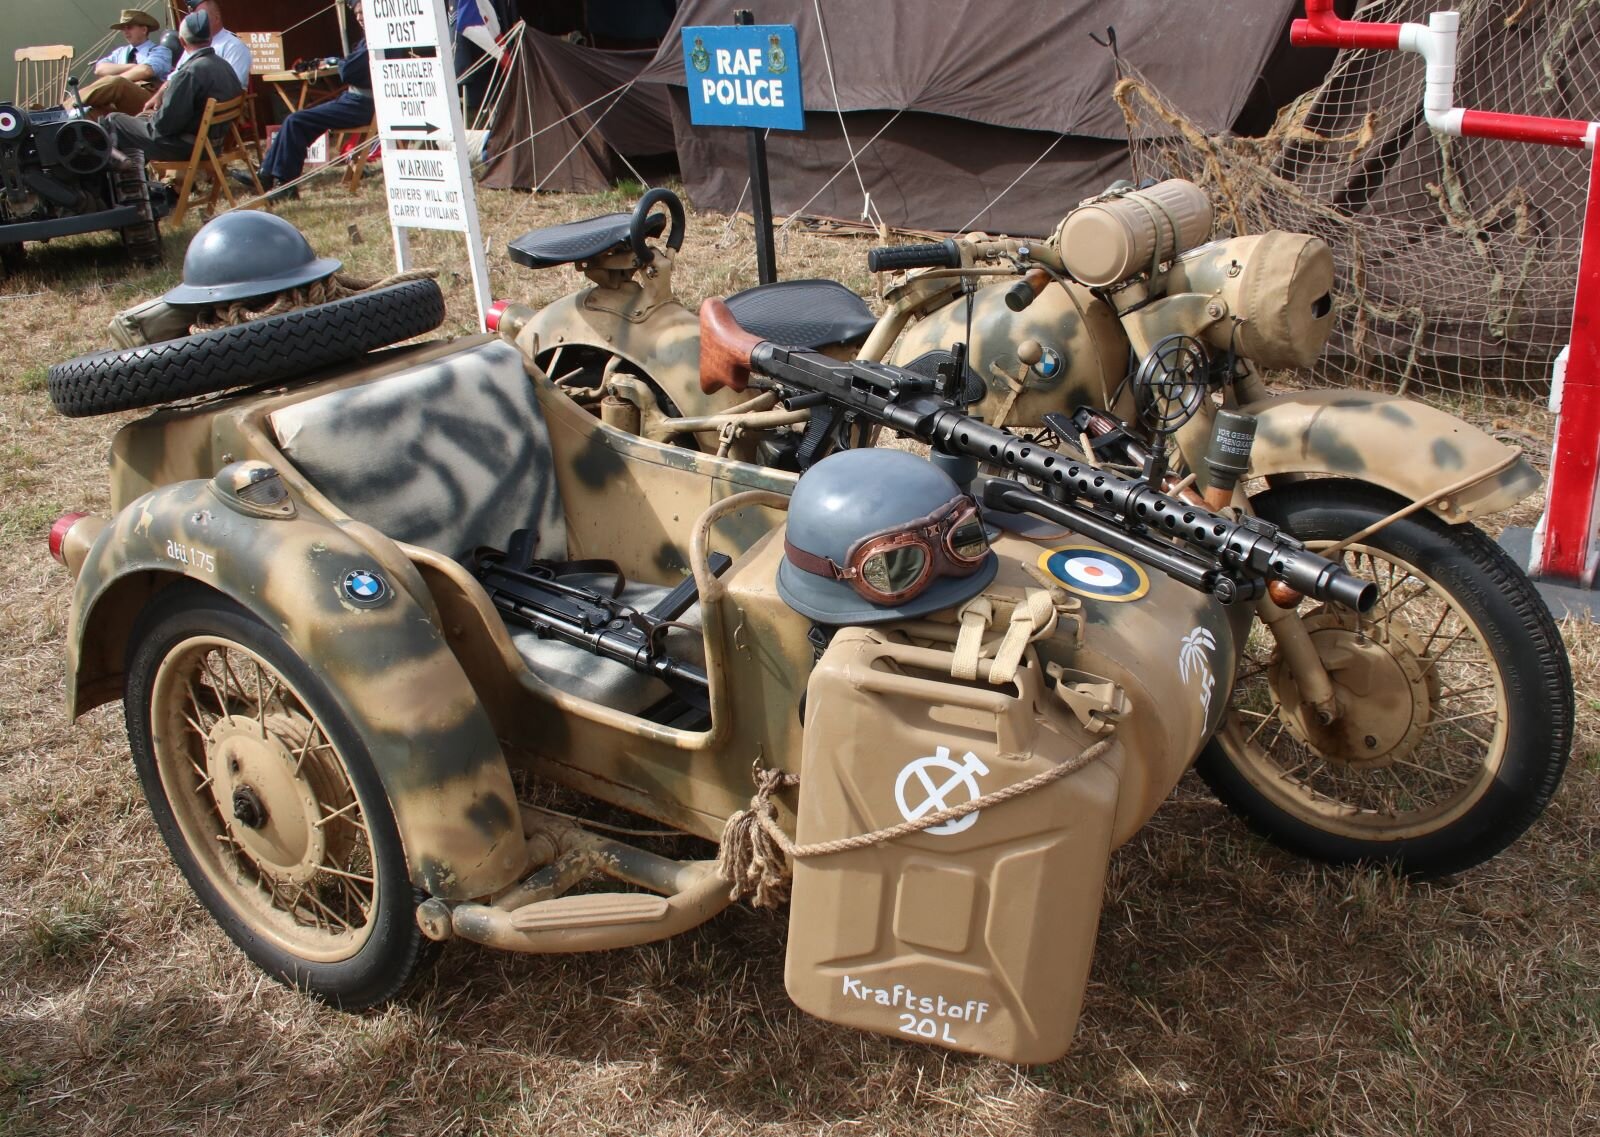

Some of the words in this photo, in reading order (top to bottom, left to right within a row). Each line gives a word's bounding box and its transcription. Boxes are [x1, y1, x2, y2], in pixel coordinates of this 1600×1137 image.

[373, 0, 424, 19] CONTROL
[250, 32, 272, 43] RAF
[387, 20, 416, 43] POST
[382, 61, 434, 80] STRAGGLER
[716, 48, 762, 76] RAF
[384, 81, 438, 98] COLLECTION
[702, 79, 785, 107] POLICE
[401, 100, 427, 117] POINT
[397, 159, 444, 177] WARNING
[390, 187, 422, 201] DRIVERS
[424, 189, 442, 202] WILL
[445, 191, 459, 203] NOT
[394, 204, 421, 217] CARRY
[424, 206, 460, 221] CIVILIANS
[190, 547, 216, 573] 1.75
[842, 975, 990, 1023] Kraftstoff
